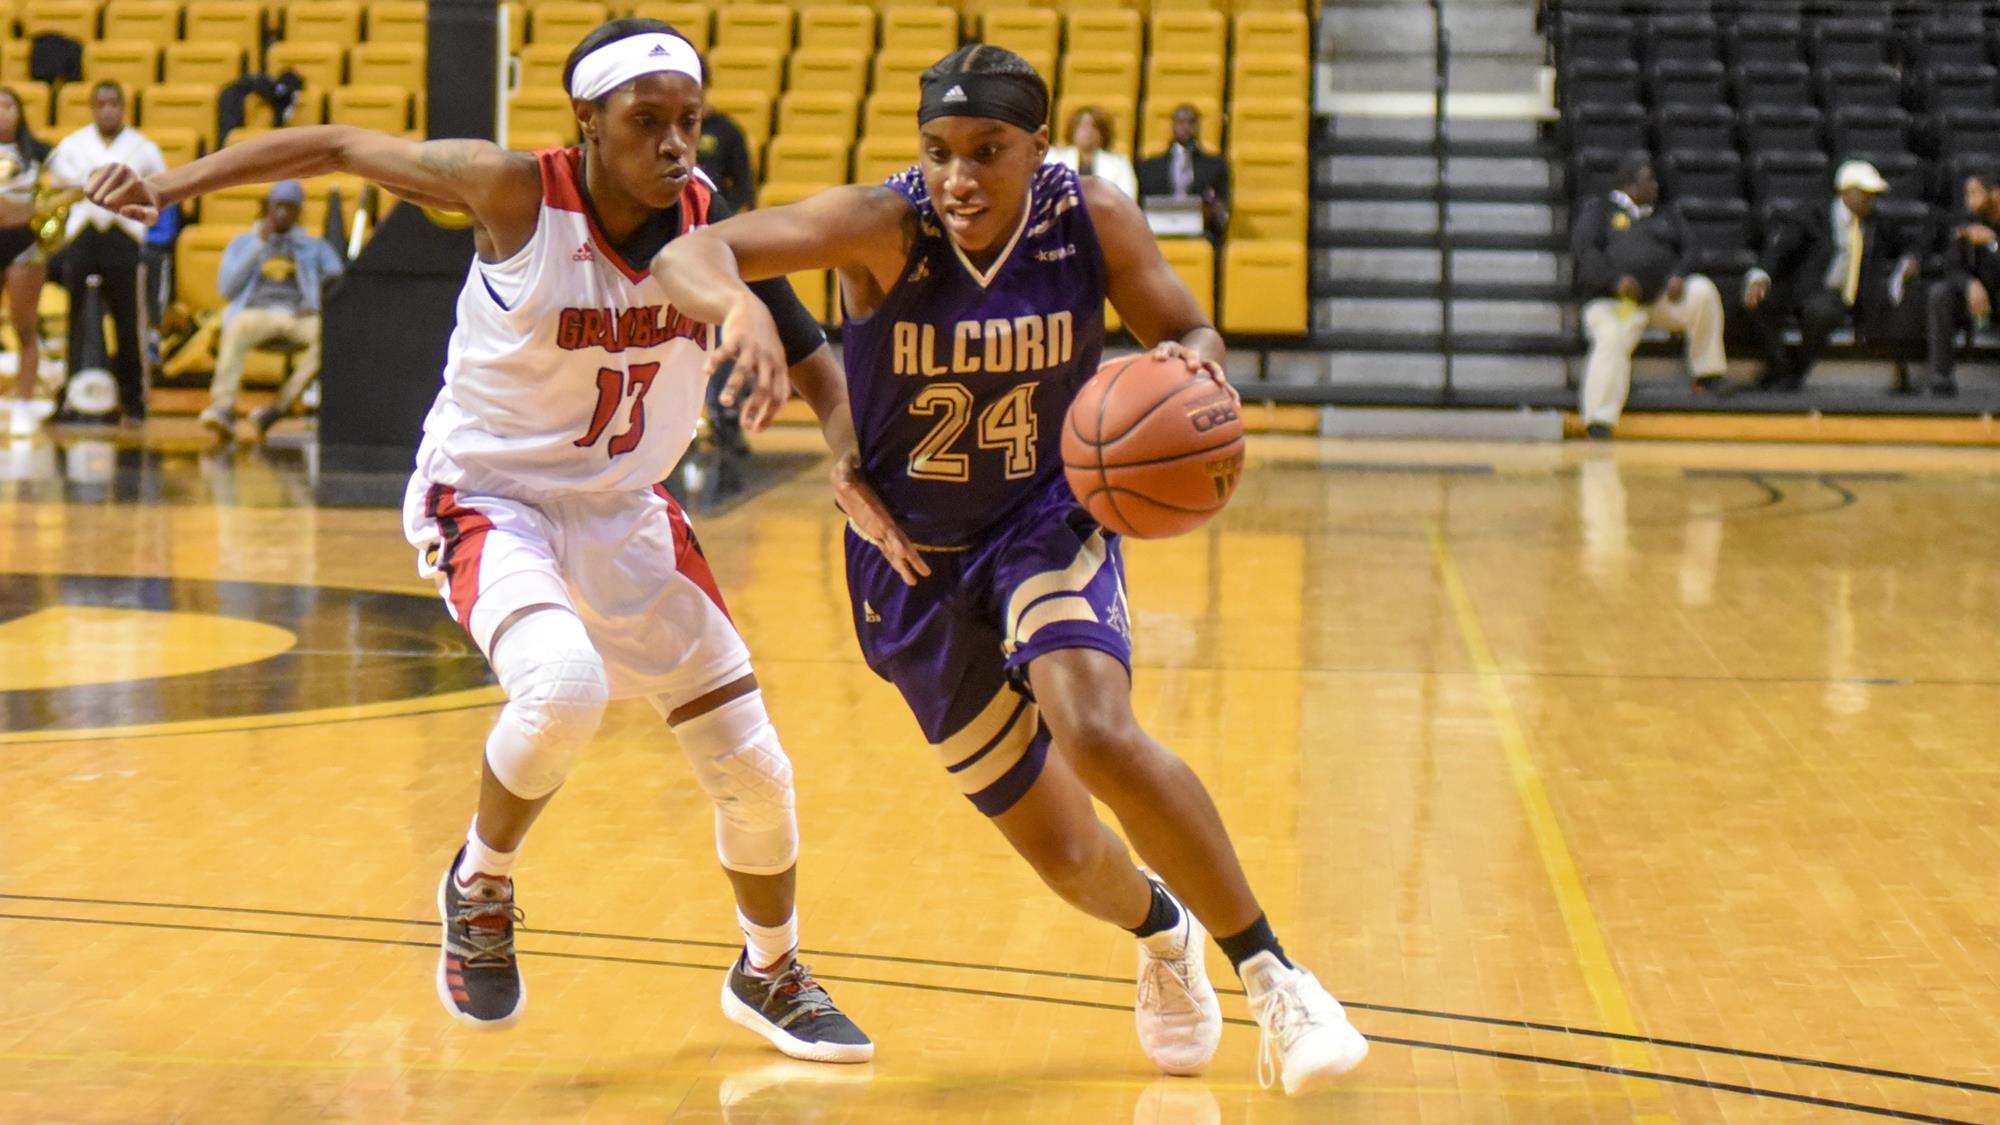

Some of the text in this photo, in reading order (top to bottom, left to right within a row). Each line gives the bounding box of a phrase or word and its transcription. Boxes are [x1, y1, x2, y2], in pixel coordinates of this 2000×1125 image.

[557, 303, 708, 353] GRAMBLIN
[893, 310, 1073, 376] ALCORN
[573, 361, 661, 459] 13
[907, 381, 1040, 482] 24
